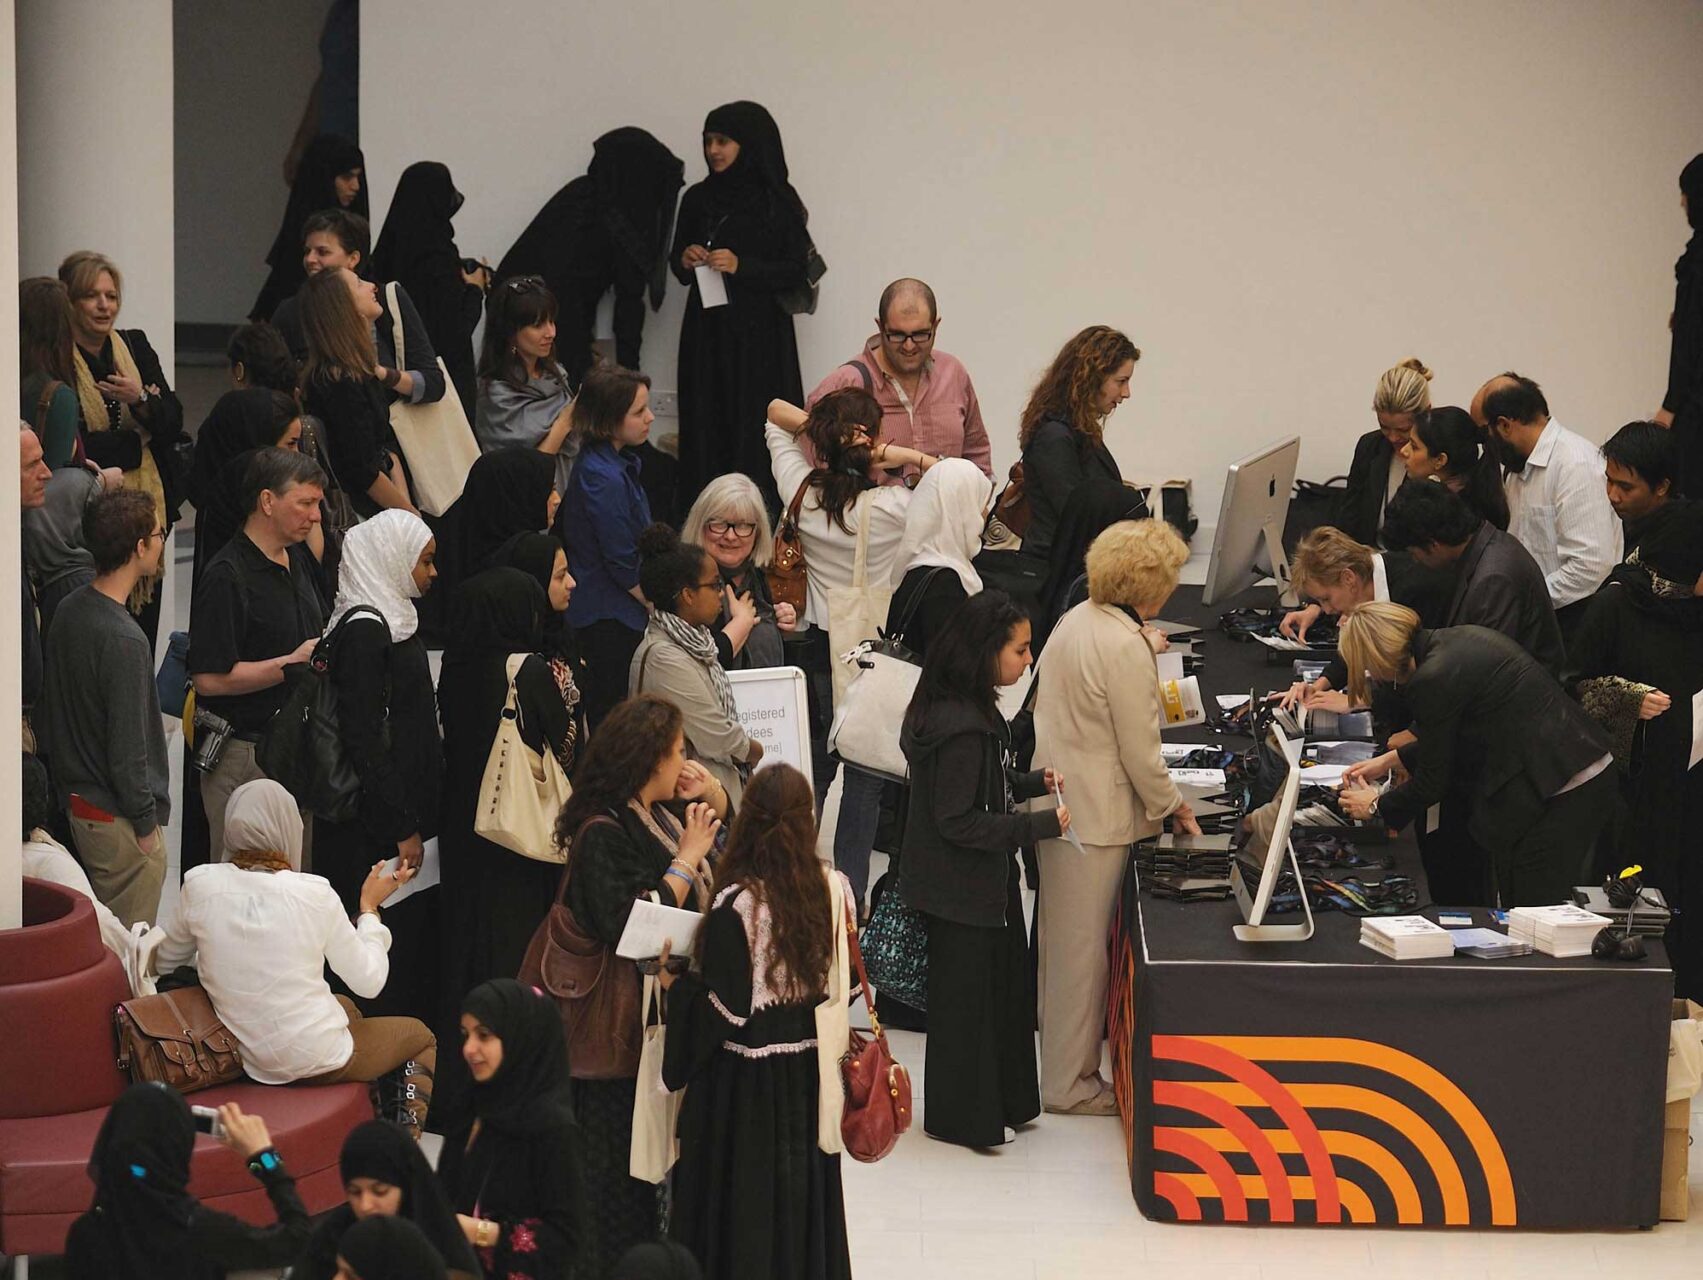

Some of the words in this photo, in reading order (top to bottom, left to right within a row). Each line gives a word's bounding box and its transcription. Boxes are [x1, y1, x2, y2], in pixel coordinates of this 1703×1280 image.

[736, 706, 785, 724] egistered
[746, 727, 773, 738] dees
[765, 742, 782, 755] me]
